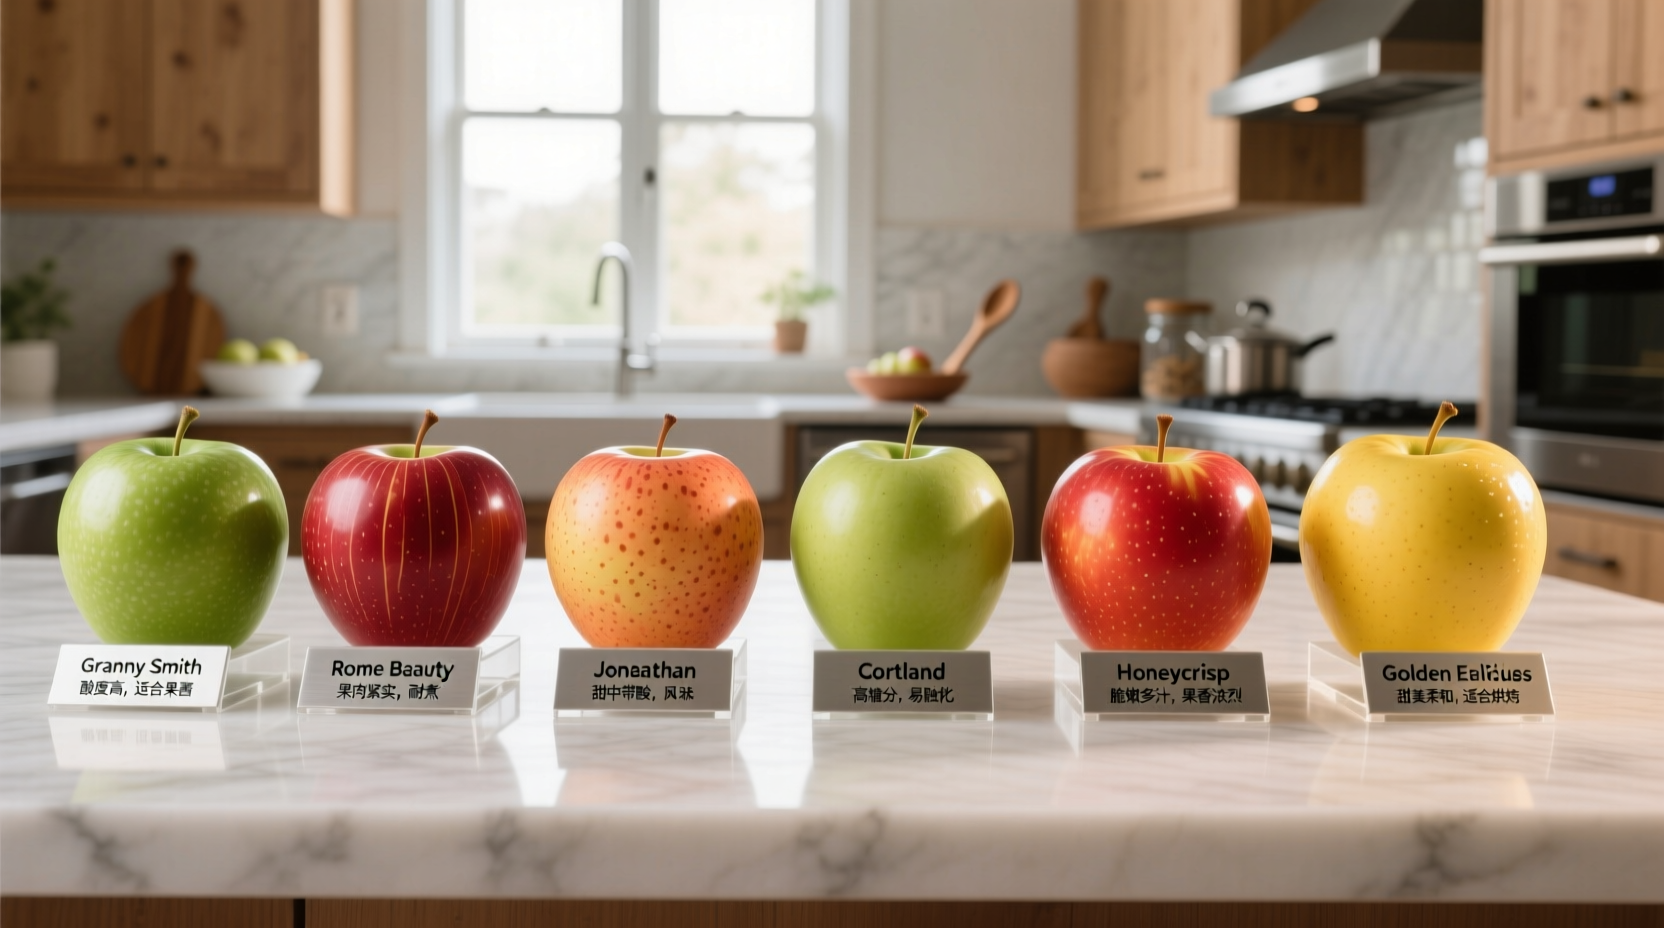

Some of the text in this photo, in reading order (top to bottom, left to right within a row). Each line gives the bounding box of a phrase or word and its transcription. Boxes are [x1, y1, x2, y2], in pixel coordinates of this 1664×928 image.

[81, 657, 202, 678] Granny Smith
[331, 660, 385, 677] Rome
[858, 661, 946, 681] Cortland
[1117, 662, 1231, 685] Honeycrisp
[1382, 663, 1452, 682] Golden
